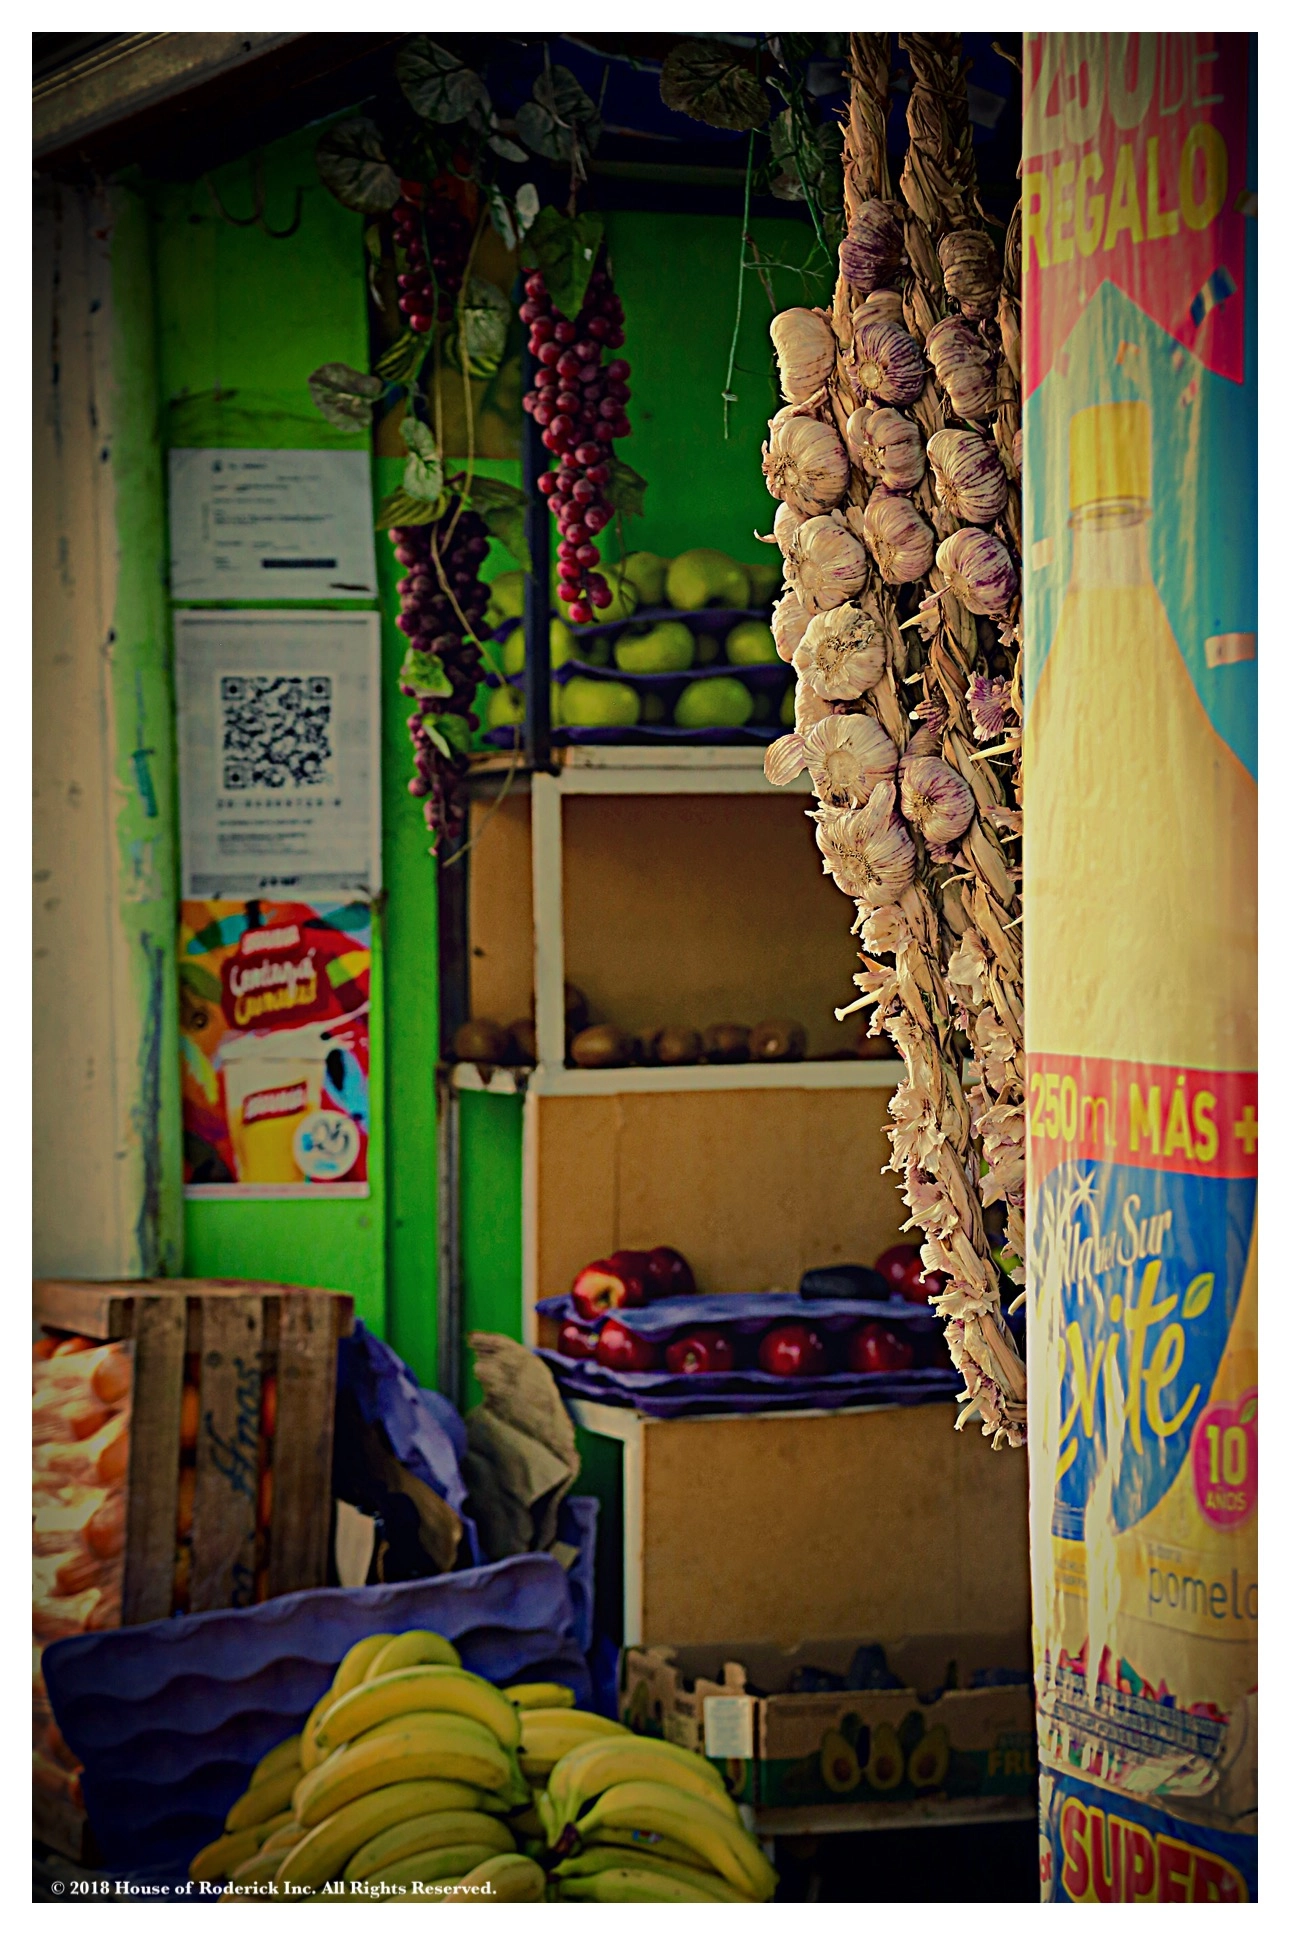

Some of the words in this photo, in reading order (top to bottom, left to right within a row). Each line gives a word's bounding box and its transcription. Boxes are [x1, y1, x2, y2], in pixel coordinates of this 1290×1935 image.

[1023, 121, 1229, 273] REGALO
[1129, 1075, 1220, 1163] MÁS
[1117, 1194, 1173, 1266] Sur
[1206, 1424, 1248, 1486] 10
[1205, 1487, 1248, 1512] AÑOS
[1061, 1797, 1248, 1903] SUPER
